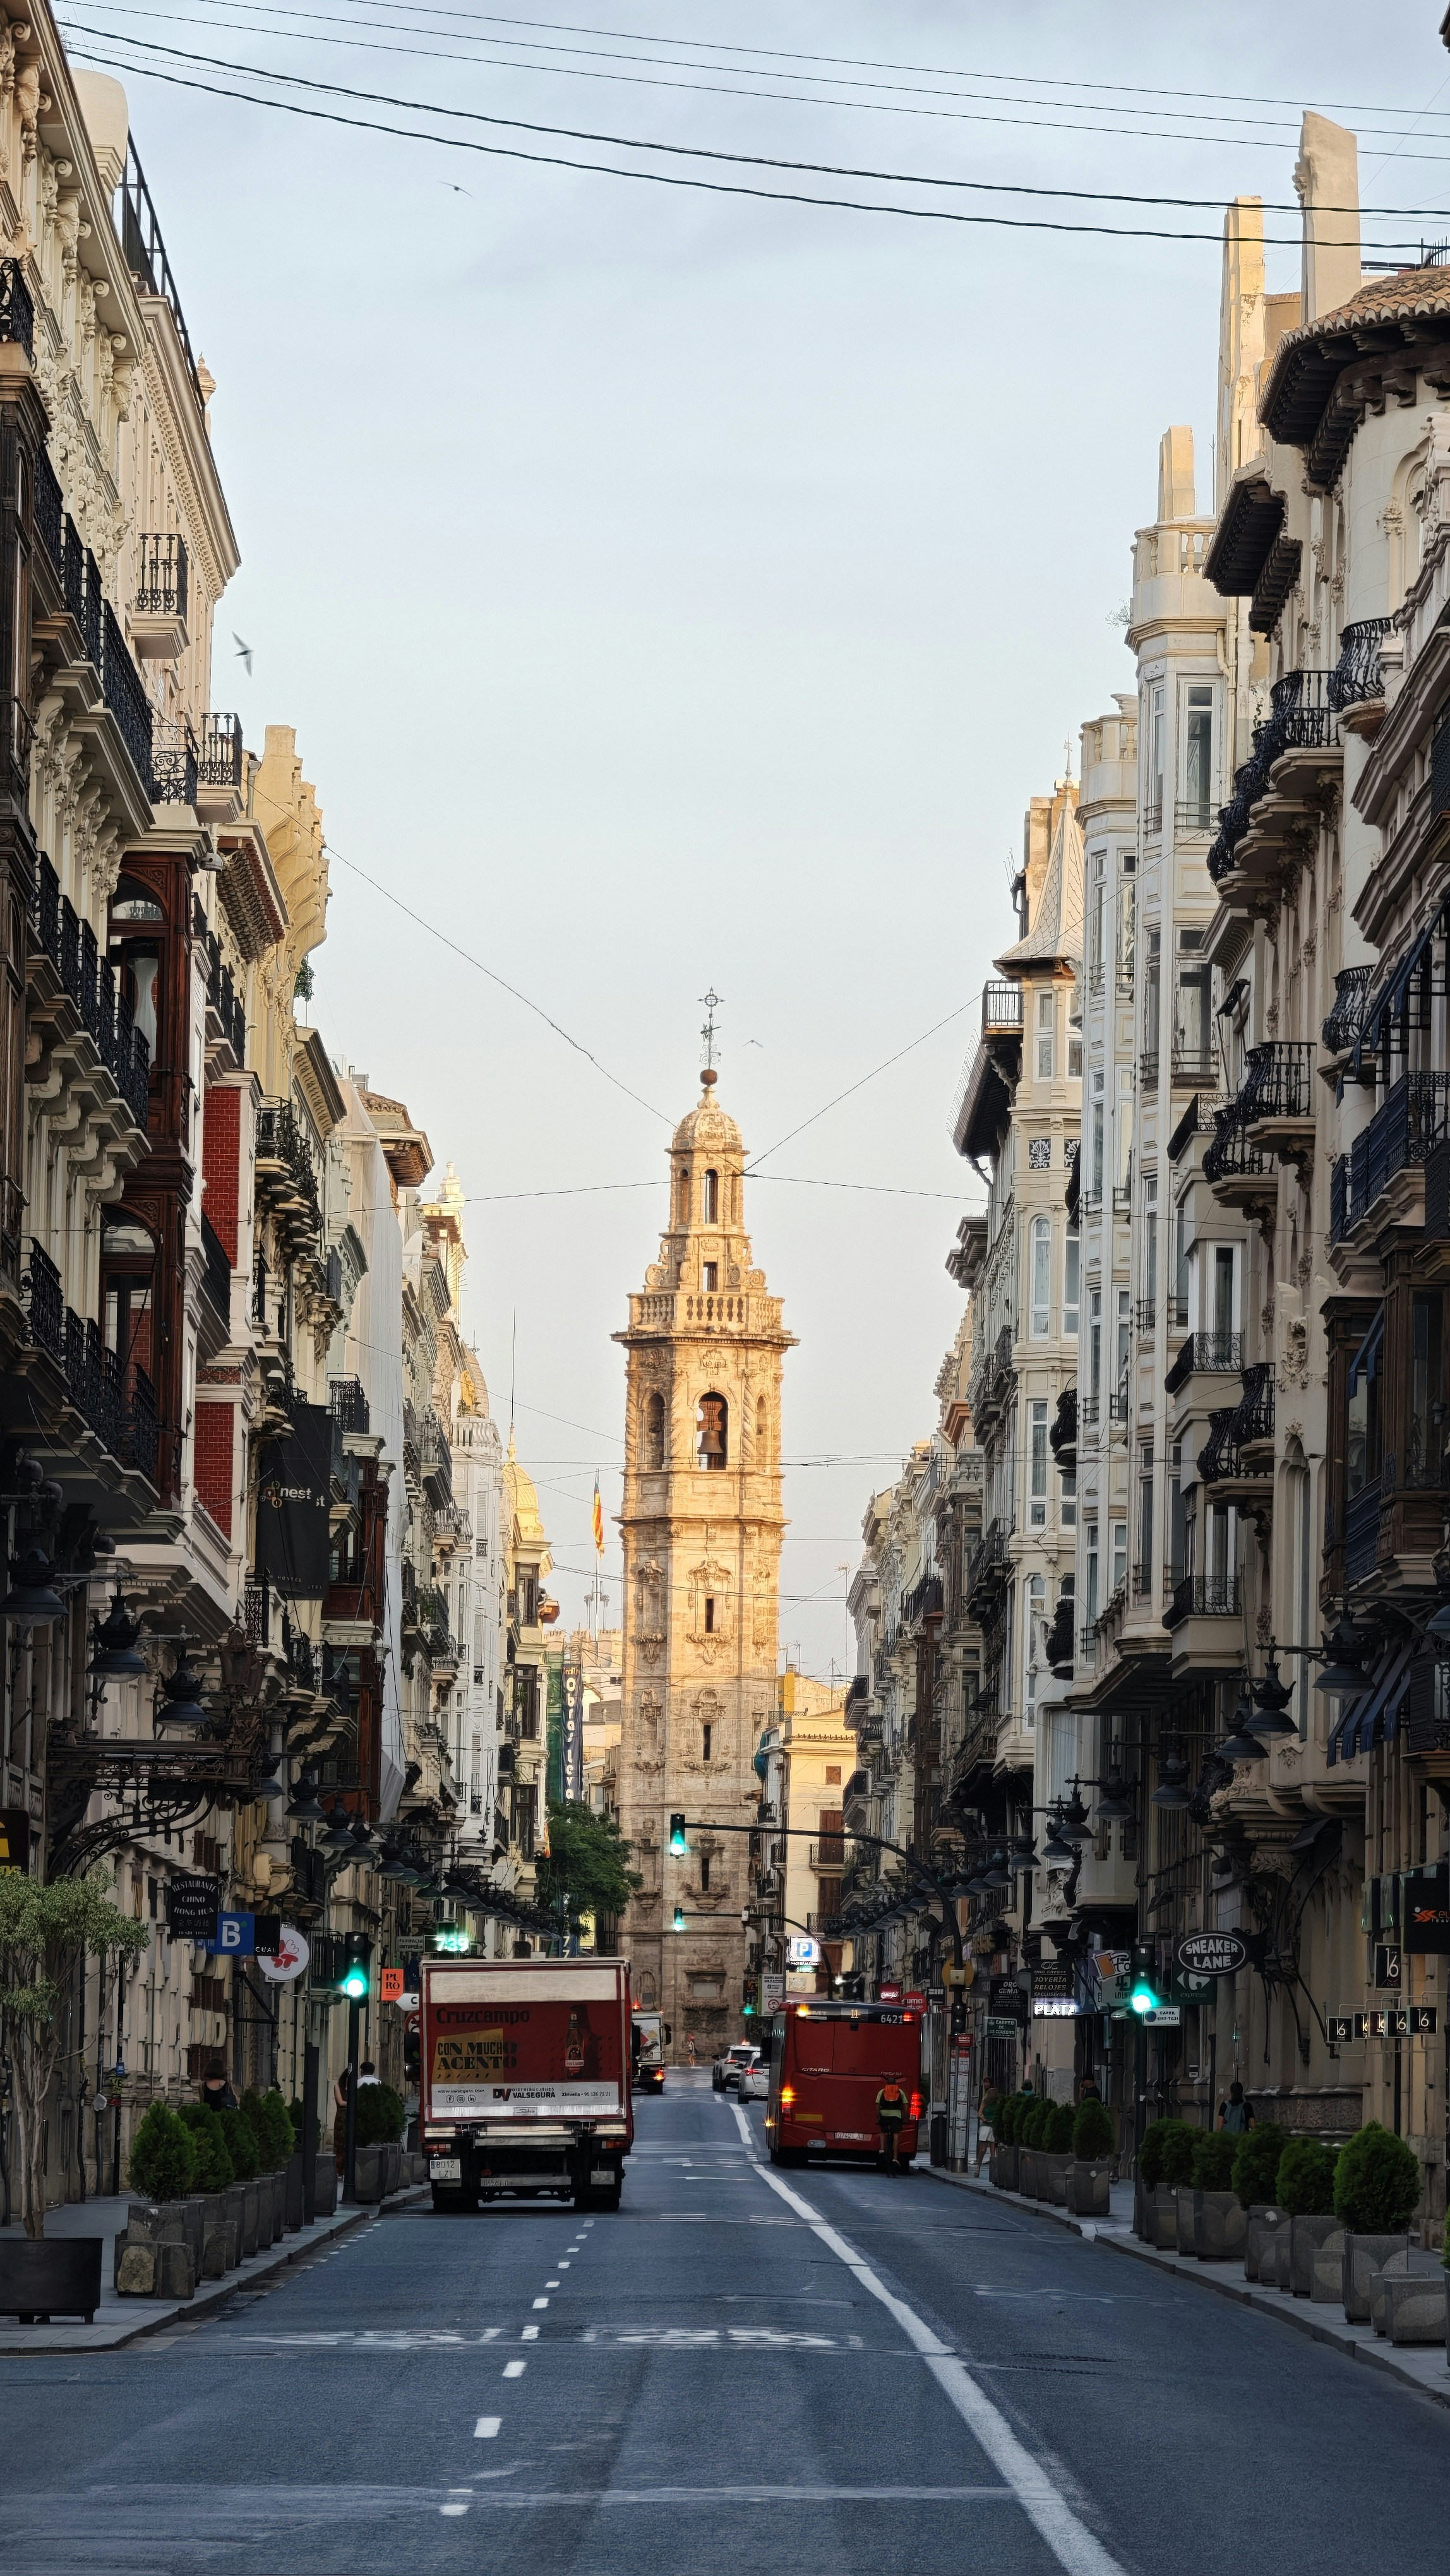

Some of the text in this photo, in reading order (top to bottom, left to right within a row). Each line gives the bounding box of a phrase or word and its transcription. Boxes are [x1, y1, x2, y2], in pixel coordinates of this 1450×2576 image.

[280, 1488, 312, 1500] nest
[172, 1880, 217, 1893] RESTAURANTE
[222, 1921, 241, 1947] B
[800, 1943, 808, 1957] P
[1186, 1939, 1238, 1954] SNEAKER
[1193, 1955, 1231, 1969] LANE
[1385, 1948, 1399, 1977] 16
[436, 2007, 530, 2025] Cruzcampo
[851, 2009, 859, 2018] 11
[1034, 2004, 1076, 2015] PLATA
[881, 2015, 903, 2024] 6421
[1395, 2012, 1406, 2030] 16
[1417, 2008, 1429, 2027] 16
[1336, 2019, 1346, 2036] 16
[438, 2041, 518, 2056] CON MUCHO
[437, 2056, 517, 2070] ACENTO
